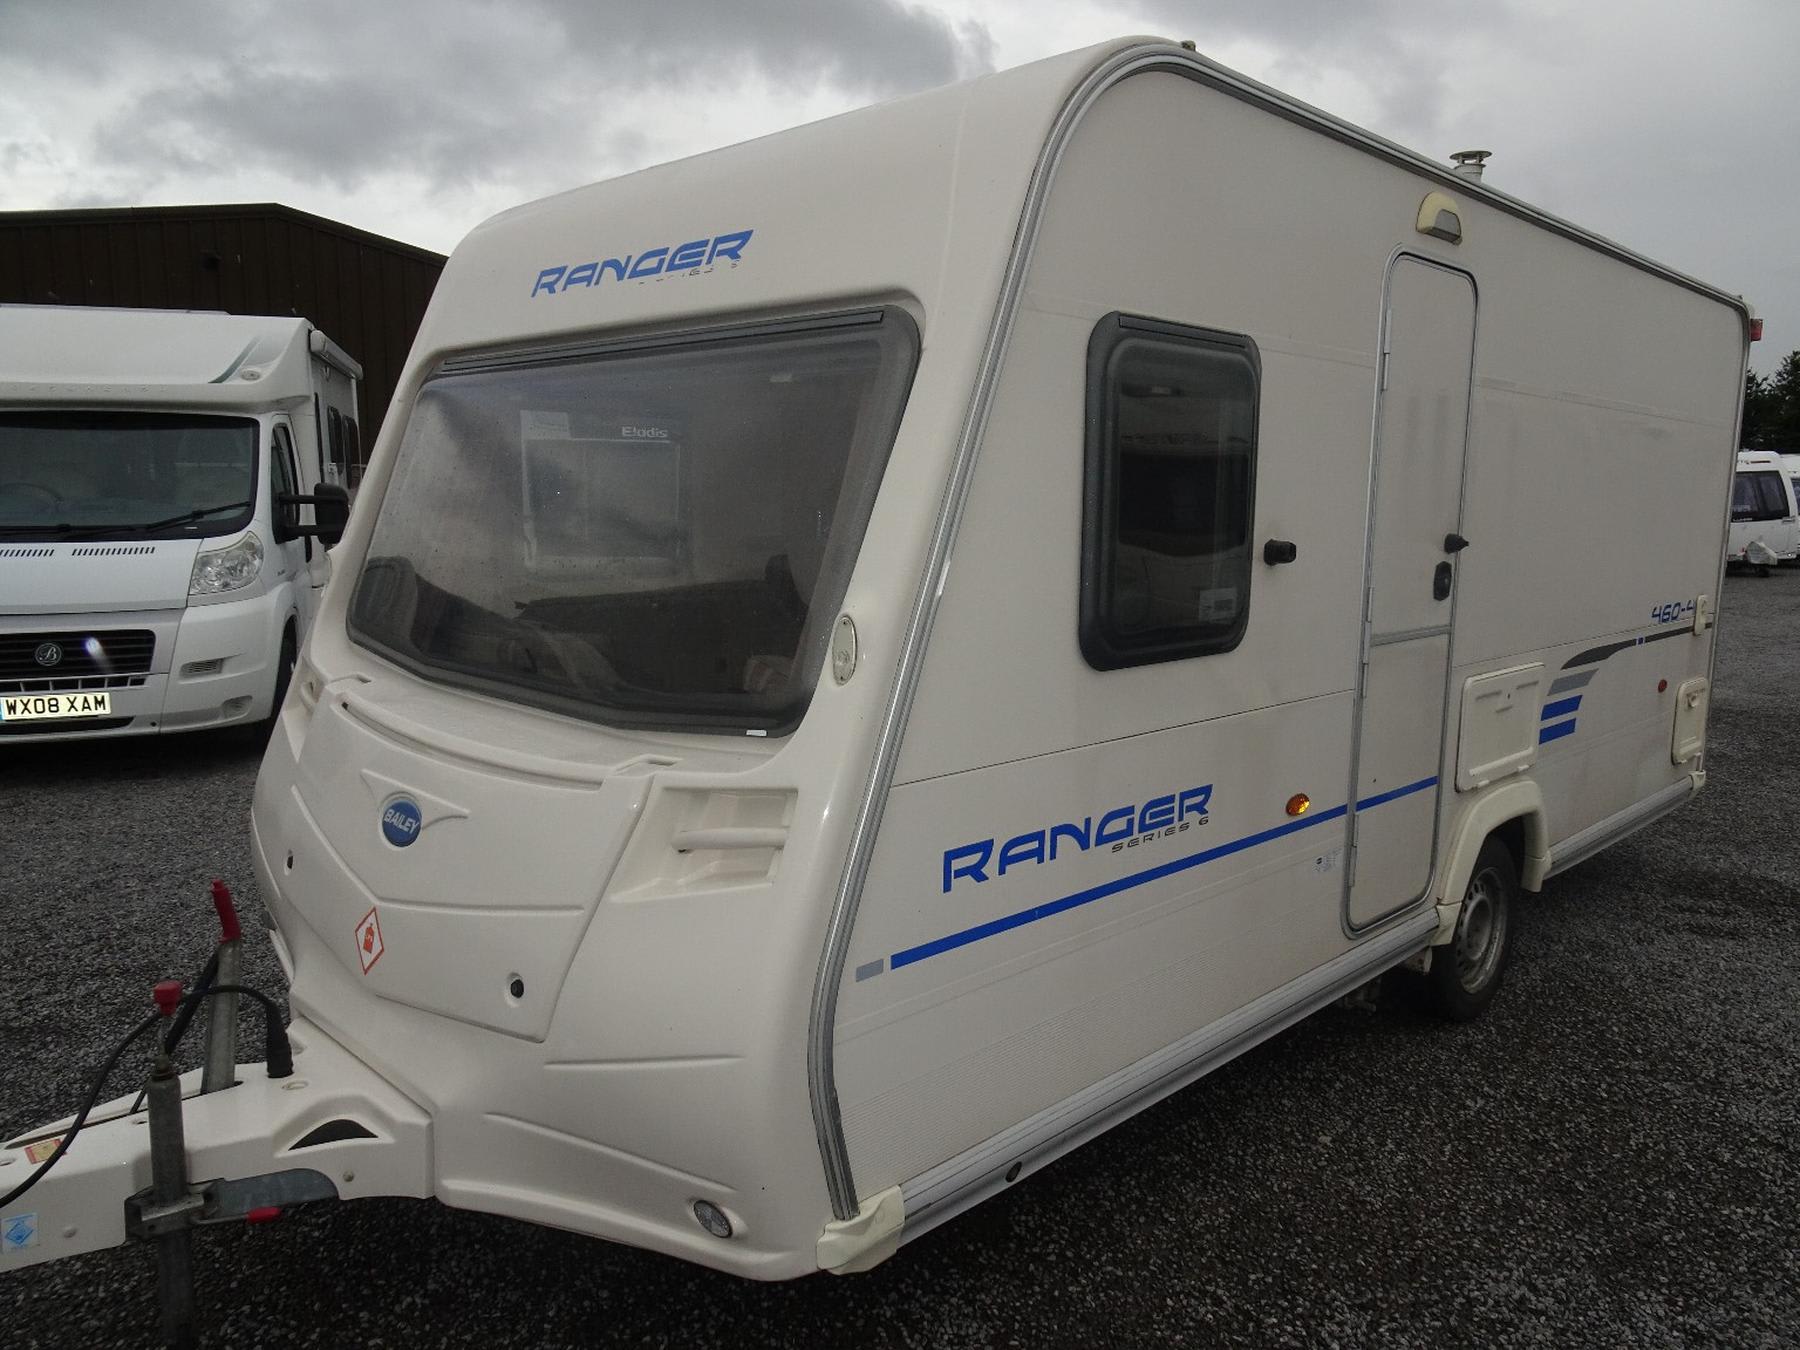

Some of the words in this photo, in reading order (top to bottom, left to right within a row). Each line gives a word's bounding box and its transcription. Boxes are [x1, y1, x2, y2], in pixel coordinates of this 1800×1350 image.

[531, 229, 754, 298] RANGER
[5, 697, 60, 715] WX08
[66, 695, 107, 713] XAM
[384, 808, 420, 835] BAILEY
[943, 783, 1213, 893] RANGER
[1112, 822, 1190, 853] SERIES
[1198, 816, 1209, 826] 6
